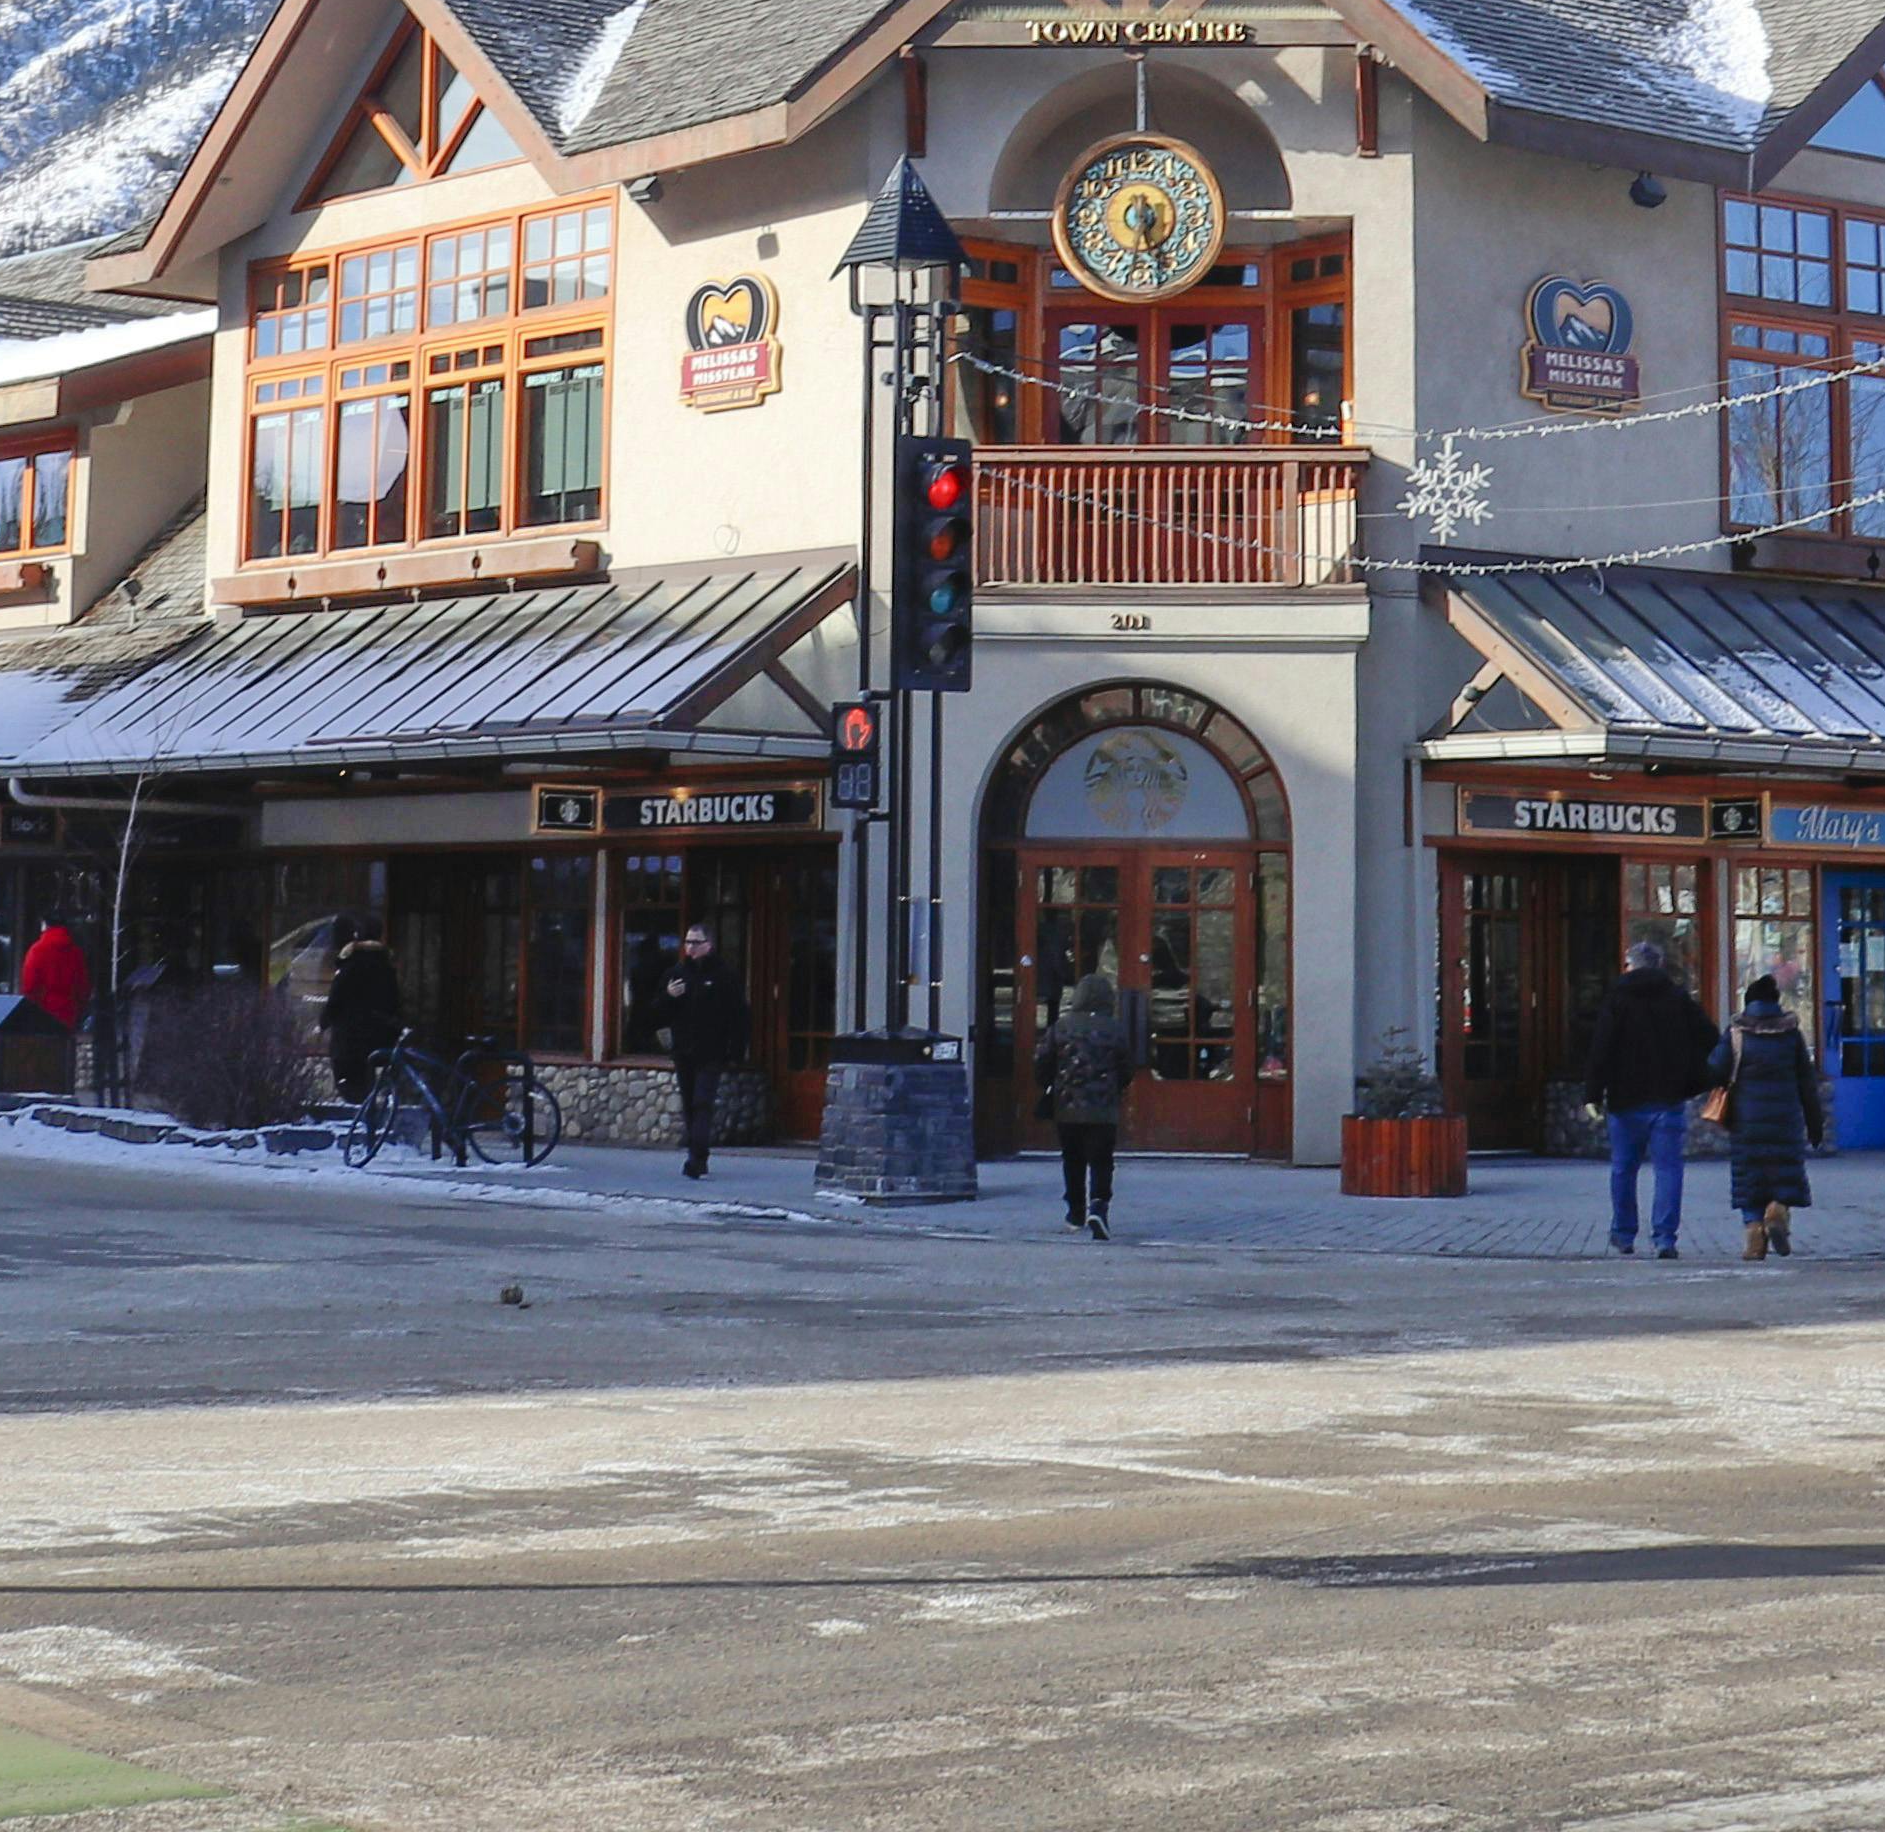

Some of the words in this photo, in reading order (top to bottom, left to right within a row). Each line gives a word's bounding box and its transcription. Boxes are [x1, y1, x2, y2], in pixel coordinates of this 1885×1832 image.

[1025, 20, 1119, 43] TOWN
[1124, 19, 1246, 43] CENTRE
[1128, 151, 1156, 172] 12
[1081, 179, 1109, 199] 10
[1179, 179, 1200, 199] 2
[1185, 205, 1206, 229] 3
[1084, 230, 1105, 251] 8
[1104, 249, 1125, 276] 7
[692, 364, 756, 387] MISSTEAK
[1548, 369, 1624, 390] MISSTEAK
[640, 794, 775, 825] STARBUCKS
[1514, 800, 1677, 834] STARBUCKS
[1796, 804, 1881, 849] Mary's
